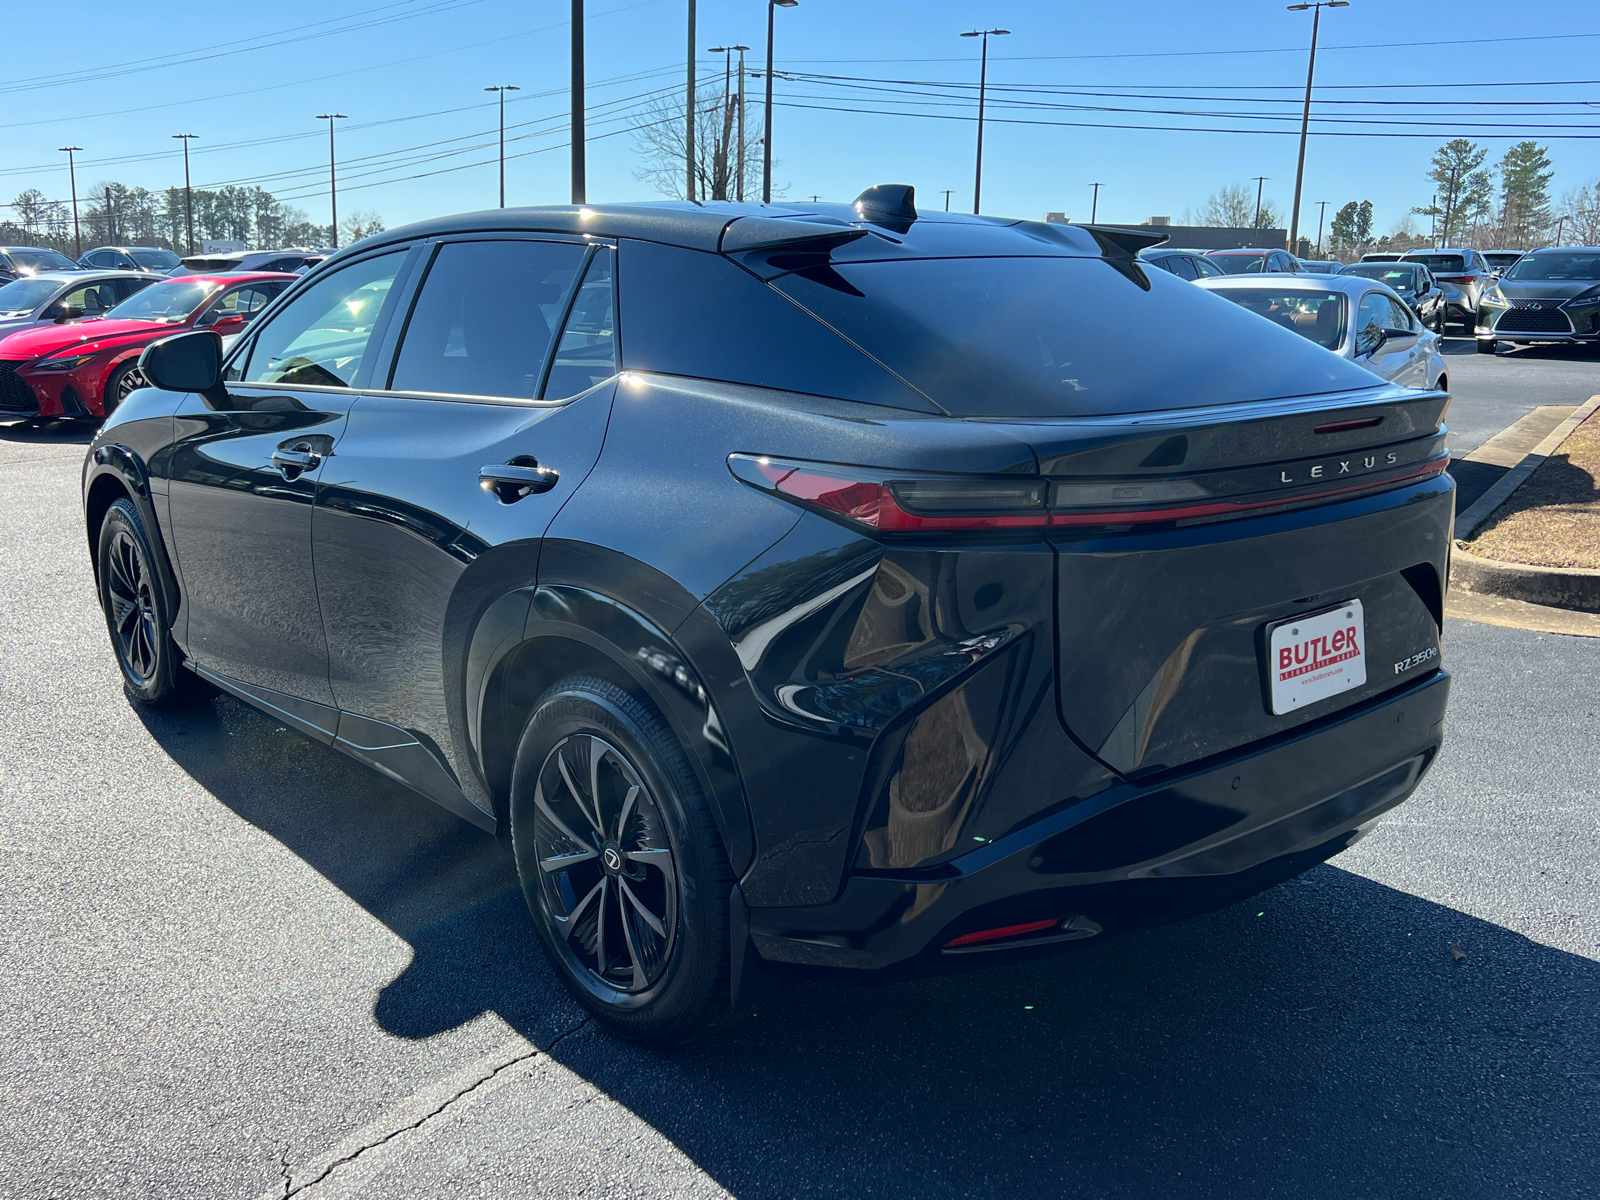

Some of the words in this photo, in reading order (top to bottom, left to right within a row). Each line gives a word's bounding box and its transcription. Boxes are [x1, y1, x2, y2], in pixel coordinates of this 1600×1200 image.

[1281, 453, 1396, 482] LEXUS
[1280, 658, 1330, 681] AUTOMOTIVE
[1336, 649, 1360, 662] GROUP
[1394, 647, 1438, 674] RZ350e
